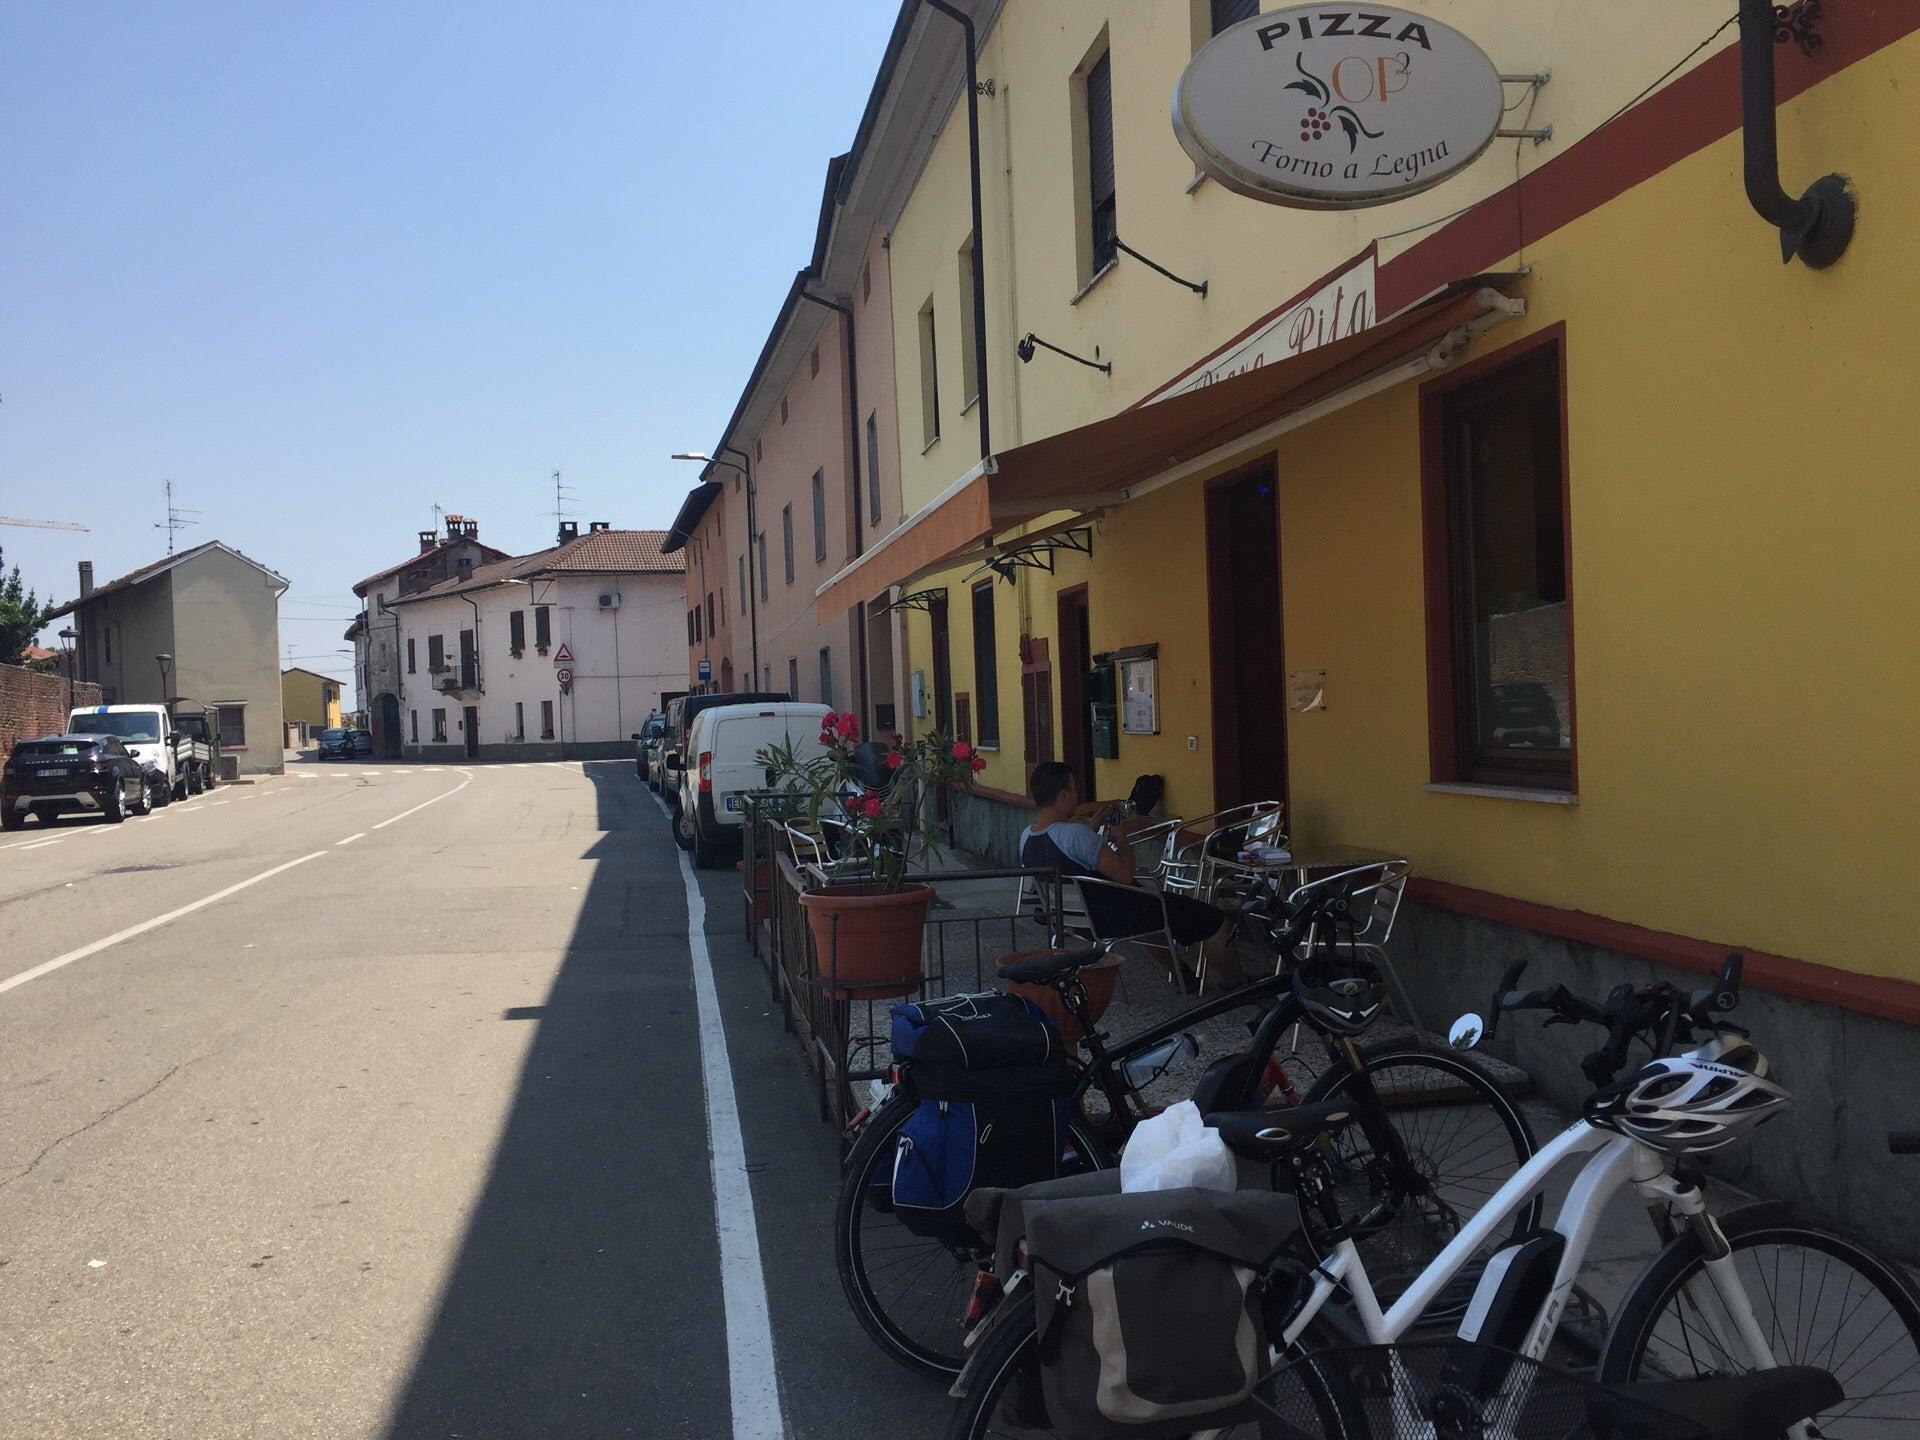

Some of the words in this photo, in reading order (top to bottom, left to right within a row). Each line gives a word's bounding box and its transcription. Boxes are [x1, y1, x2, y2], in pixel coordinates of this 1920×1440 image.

[1256, 13, 1432, 51] PIZZA
[1252, 140, 1333, 178] Forno
[1343, 163, 1359, 179] a
[1367, 140, 1449, 182] Legna
[560, 672, 570, 680] 30
[1158, 1219, 1196, 1234] VAUDE
